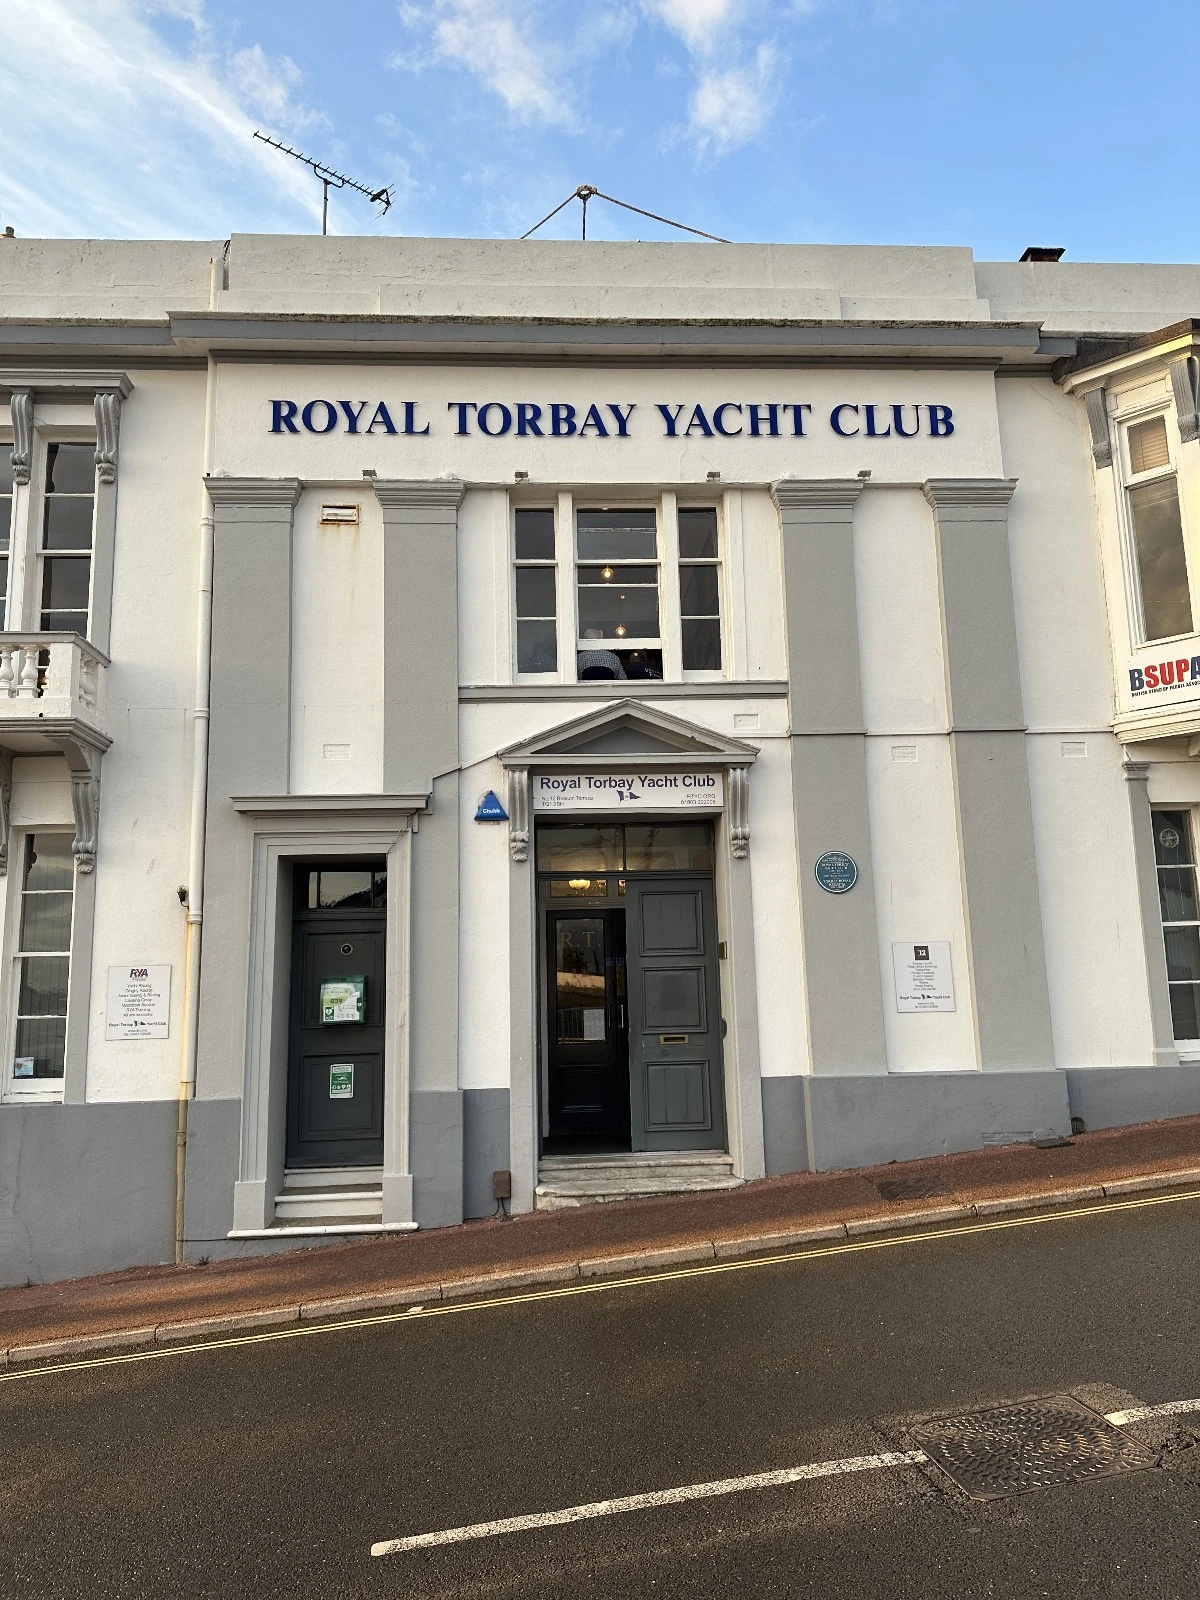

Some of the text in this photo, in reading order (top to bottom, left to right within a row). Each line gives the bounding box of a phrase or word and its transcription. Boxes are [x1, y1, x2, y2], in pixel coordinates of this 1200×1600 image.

[267, 399, 955, 437] ROYAL TORBAY YACHT CLUB
[1129, 656, 1200, 691] BSUPA
[540, 774, 716, 792] Royal Torbay Yacht Club
[129, 968, 149, 978] RYA
